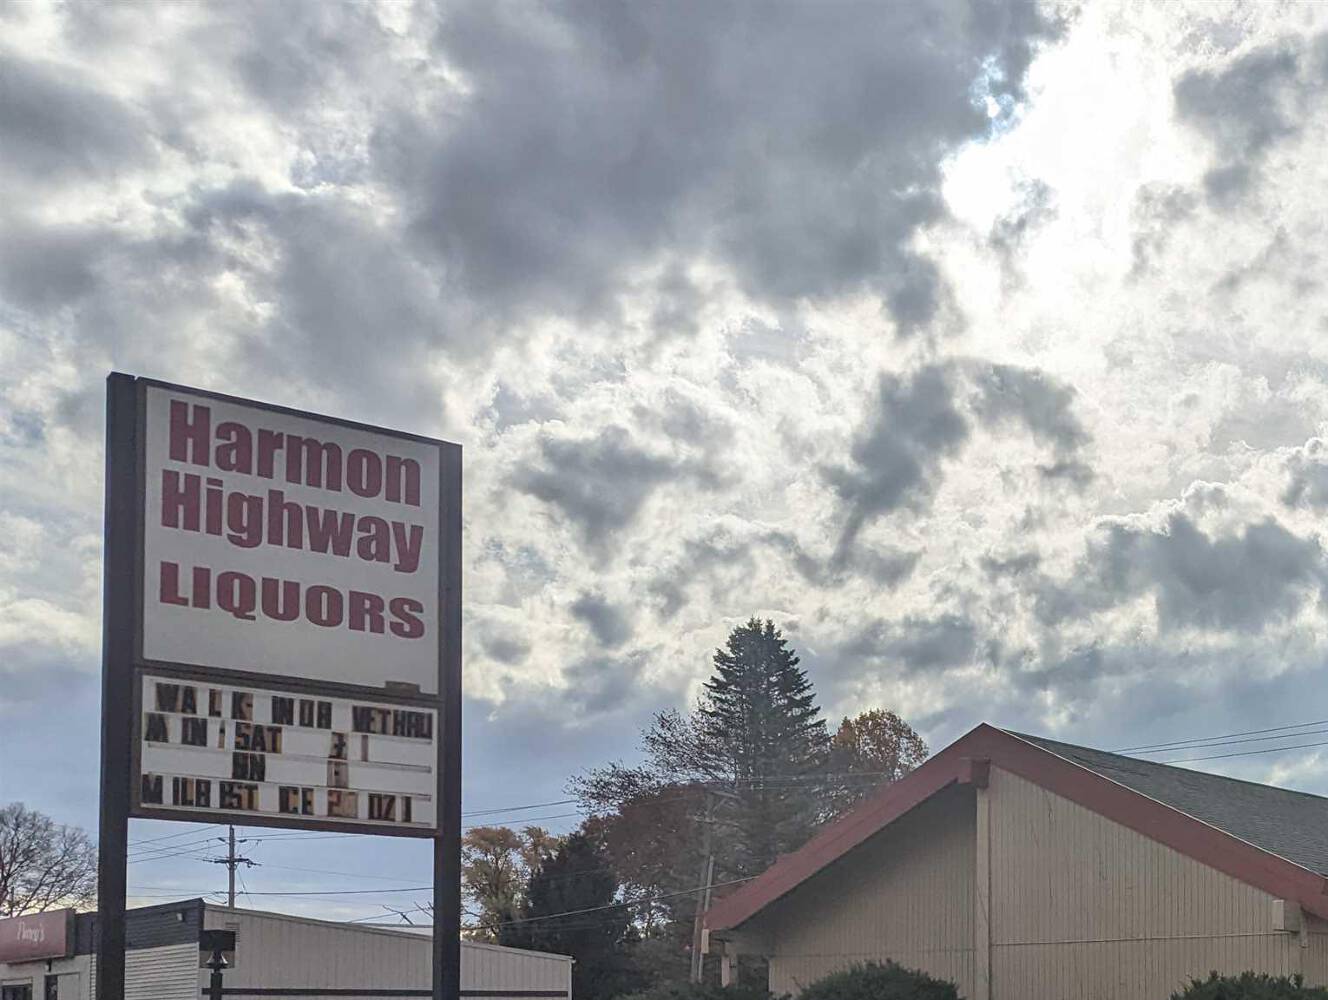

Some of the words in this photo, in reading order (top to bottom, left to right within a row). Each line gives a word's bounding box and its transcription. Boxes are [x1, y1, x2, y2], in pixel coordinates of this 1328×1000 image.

[169, 398, 421, 507] Harmon
[161, 468, 424, 574] Highway
[159, 560, 426, 640] LIQUORS
